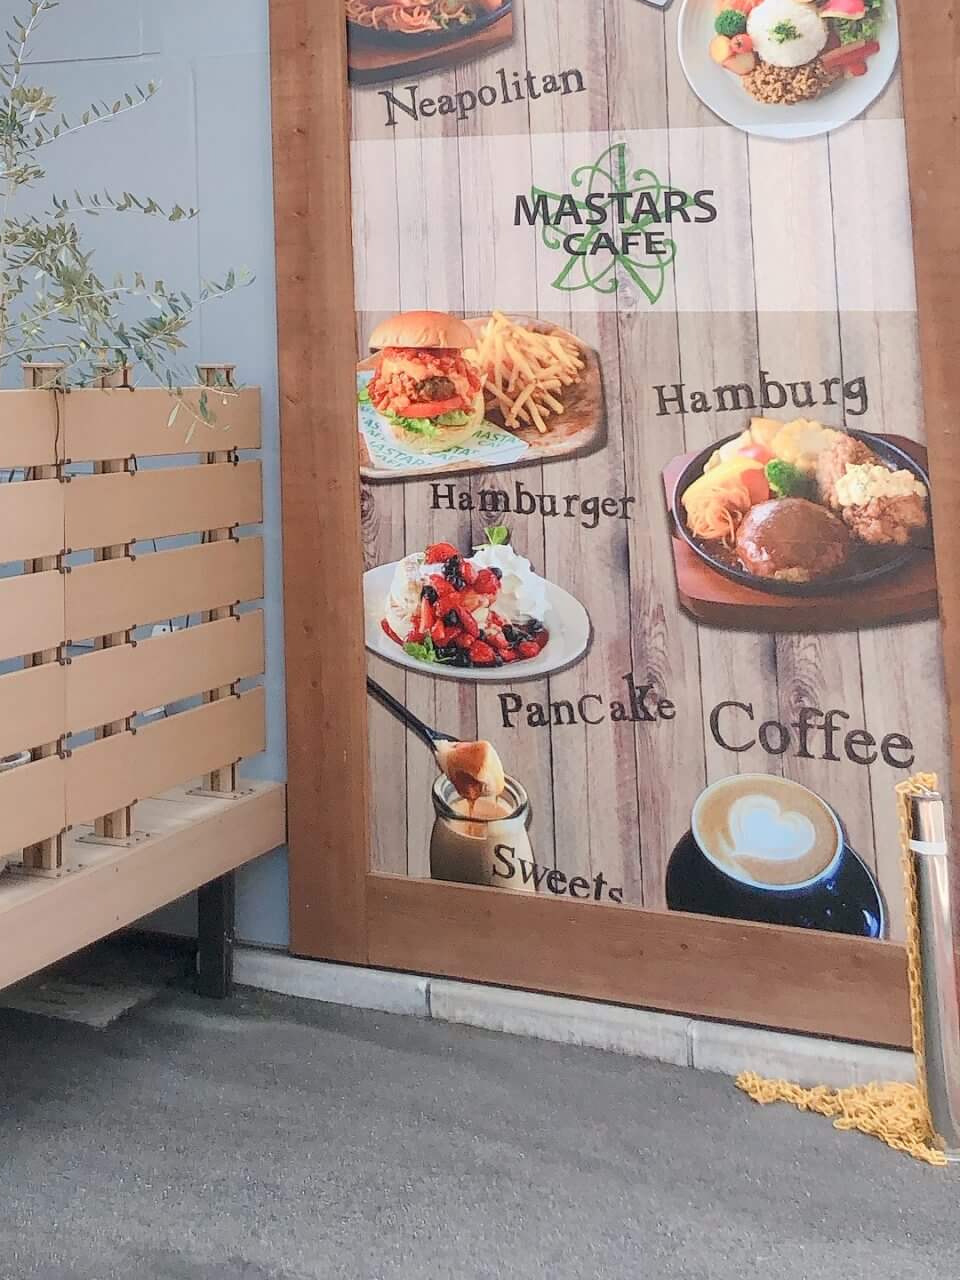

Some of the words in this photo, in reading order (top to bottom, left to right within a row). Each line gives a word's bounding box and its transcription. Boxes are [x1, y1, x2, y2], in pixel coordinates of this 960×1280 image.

[377, 67, 587, 126] Neapolitan
[513, 188, 718, 227] MASTARS
[562, 231, 667, 256] CAFE
[654, 371, 868, 417] Hamburg
[430, 482, 636, 529] Hamburger
[709, 700, 916, 769] Coffee
[492, 843, 623, 904] Sweets
